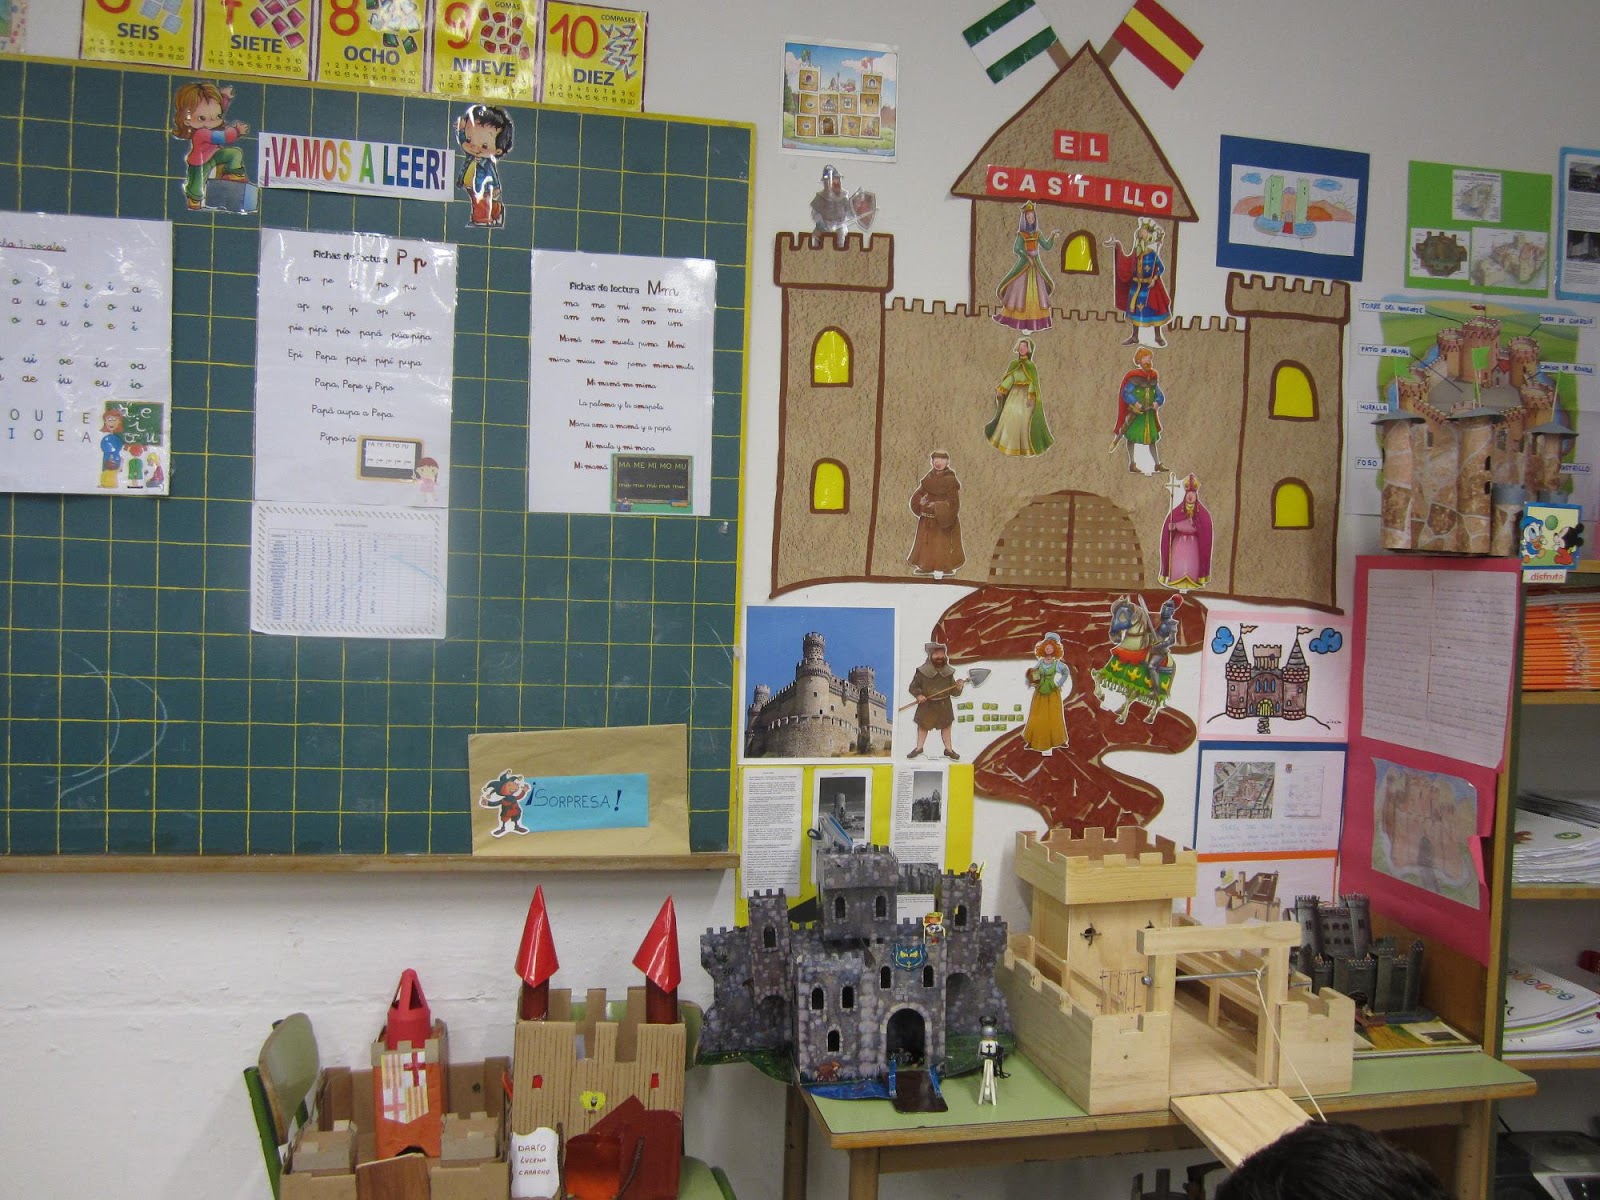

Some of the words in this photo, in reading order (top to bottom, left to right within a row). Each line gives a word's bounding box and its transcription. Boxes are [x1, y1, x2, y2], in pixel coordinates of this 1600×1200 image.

[330, 0, 360, 36] 8
[601, 14, 635, 23] COMPASES
[117, 22, 159, 40] SEIS
[445, 2, 472, 49] 9
[550, 14, 598, 59] 10
[231, 35, 282, 53] SIETE
[344, 46, 399, 65] OCHO
[453, 57, 515, 77] NUEVE
[574, 68, 614, 86] DIEZ
[1060, 136, 1101, 156] EL
[264, 137, 352, 186] ¡VAMOS
[359, 144, 374, 184] A
[383, 145, 446, 190] LEER!
[992, 172, 1168, 208] CASTILLO
[314, 250, 340, 260] Fichas
[297, 275, 311, 284] pa
[321, 277, 334, 286] pe
[376, 282, 389, 291] po
[570, 282, 595, 291] Fichas
[598, 284, 608, 292] de
[611, 284, 640, 294] lectura
[297, 302, 310, 312] ap
[322, 304, 333, 314] ep
[349, 305, 358, 315] ip
[377, 308, 388, 318] op
[404, 310, 416, 320] up
[617, 316, 630, 324] im
[639, 340, 659, 348] puma
[288, 348, 303, 360] Epi
[316, 351, 337, 364] Pepa
[399, 359, 422, 368] pupa
[342, 380, 363, 392] Pepe
[366, 384, 372, 392] y
[375, 382, 394, 393] Pipo
[587, 378, 596, 386] Mi
[636, 381, 656, 389] mima
[590, 400, 615, 408] paloma
[633, 403, 663, 412] amapola
[83, 413, 90, 424] E
[337, 409, 360, 418] aupa
[569, 419, 590, 427] Manu
[58, 430, 64, 441] E
[82, 431, 91, 443] A
[320, 432, 339, 444] Pipo
[585, 441, 594, 449] Mi
[635, 445, 655, 453] mapa
[574, 462, 583, 470] Mi
